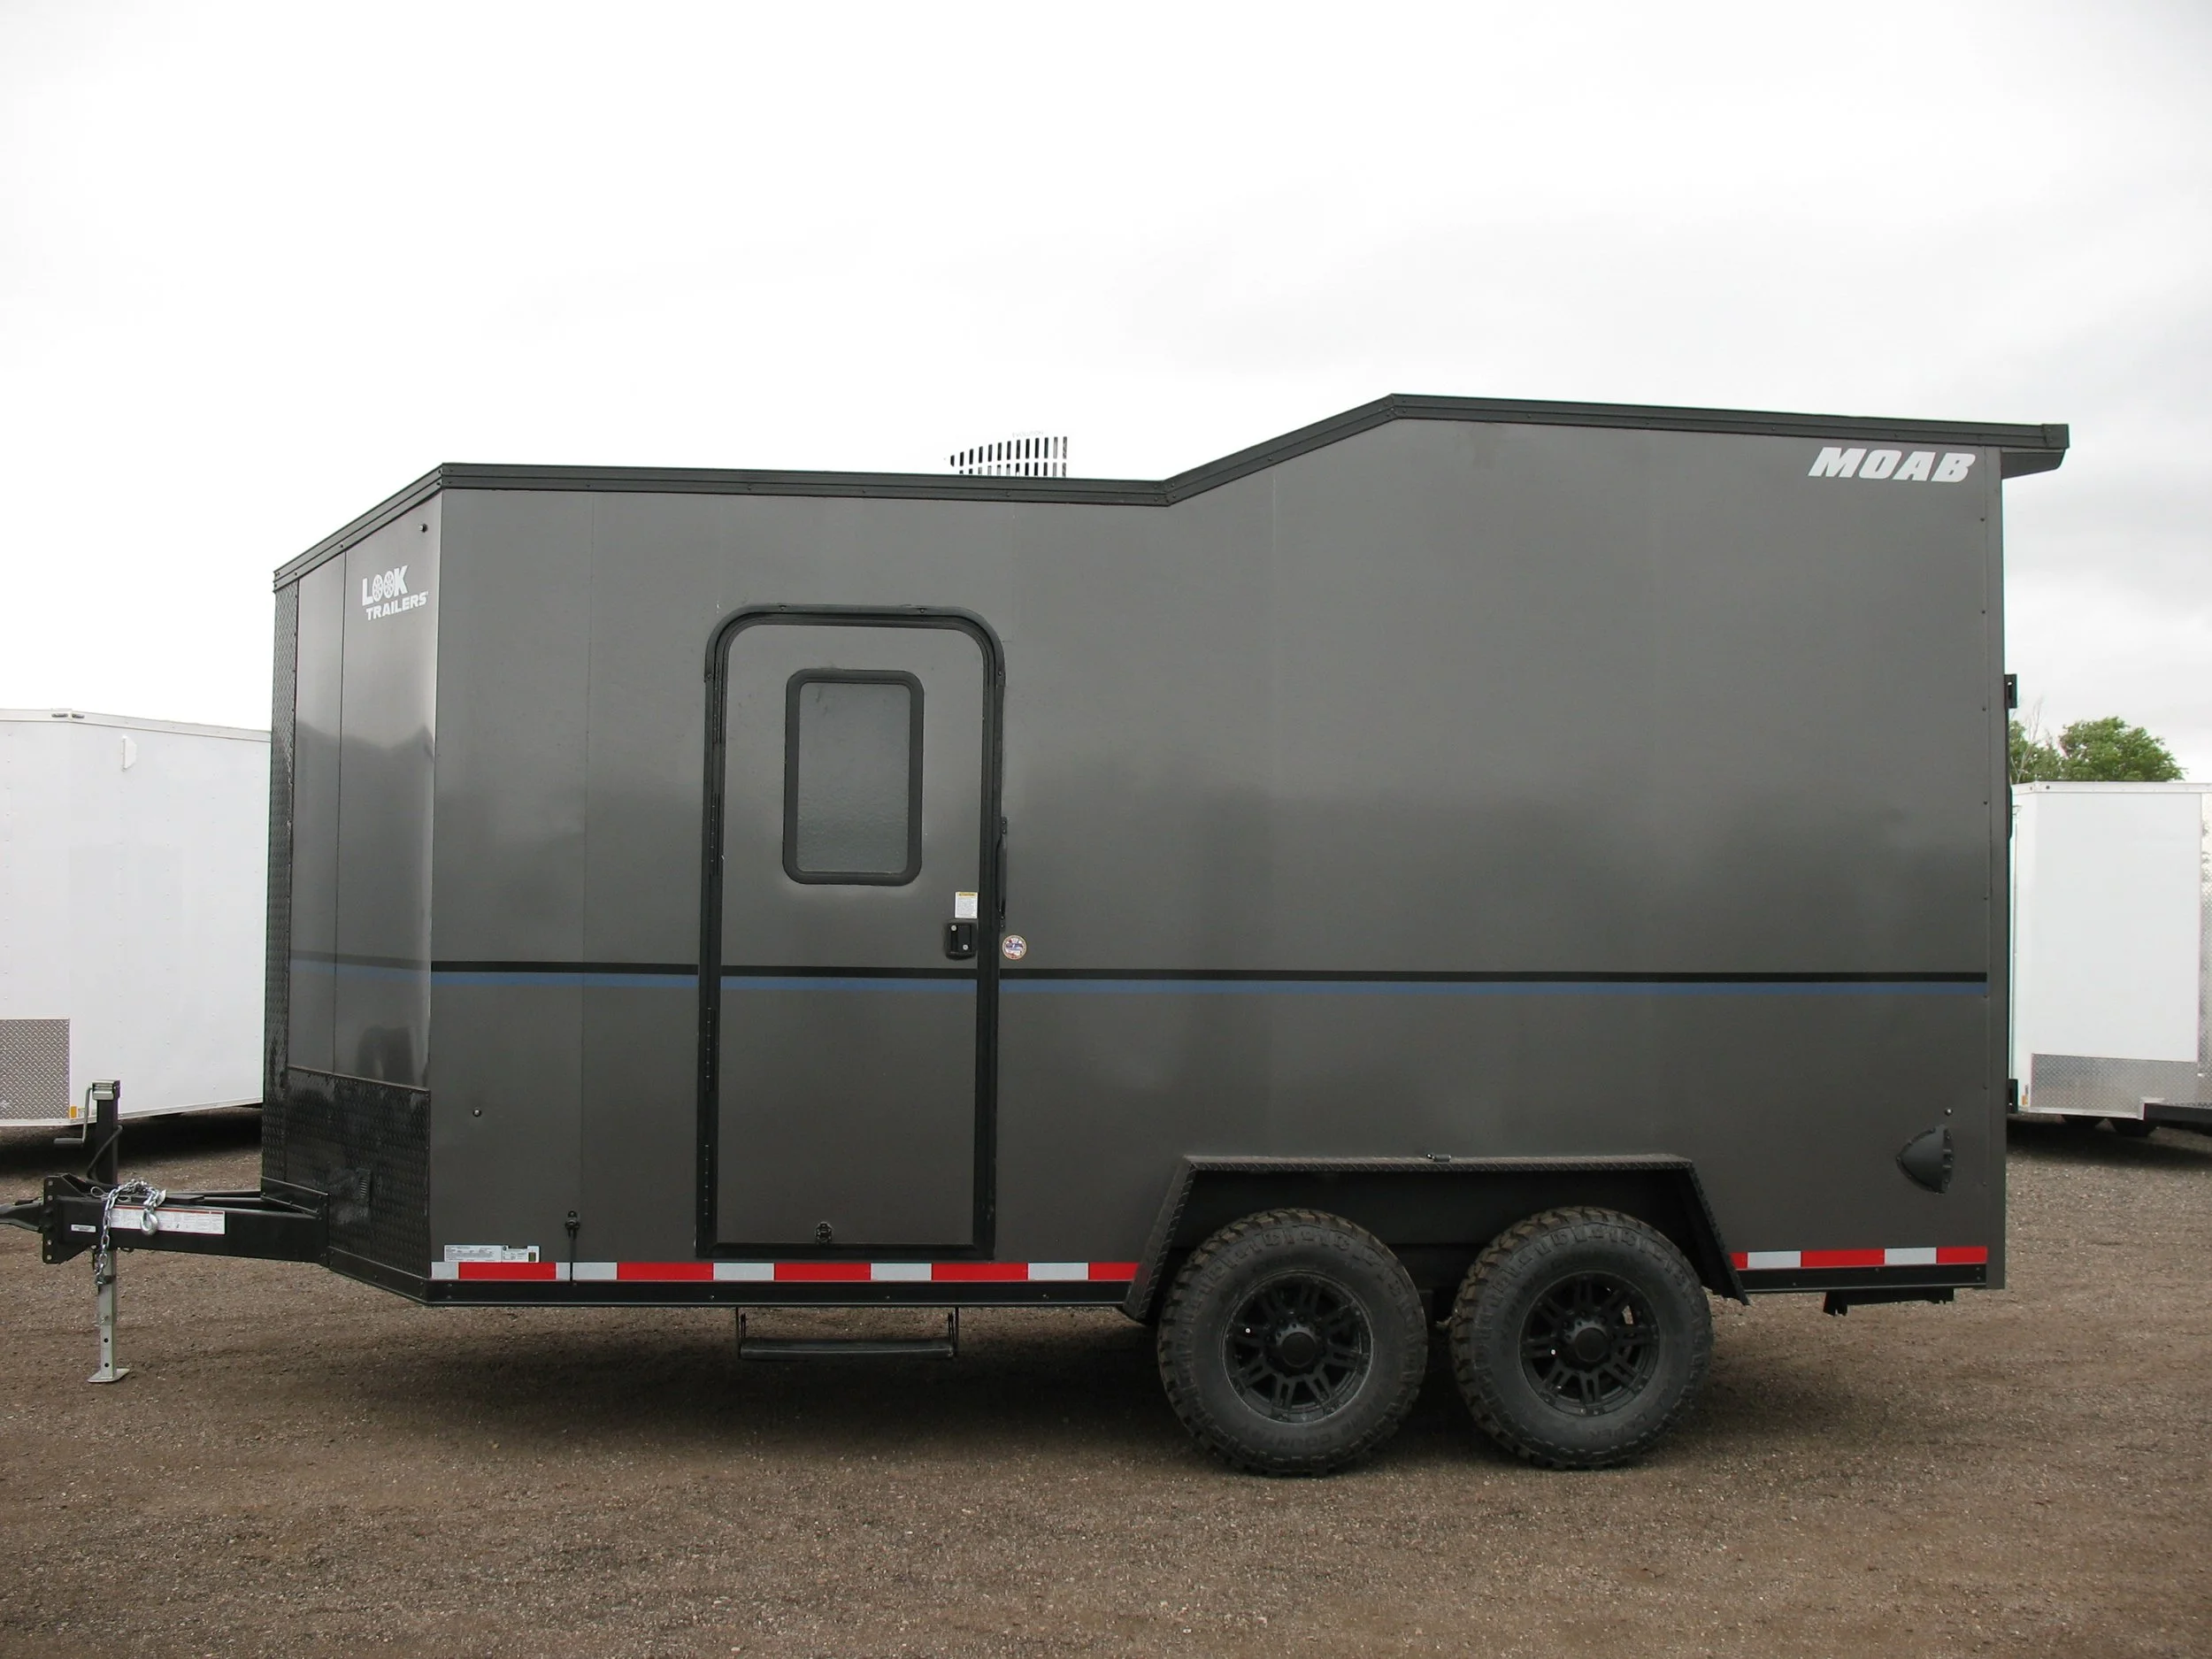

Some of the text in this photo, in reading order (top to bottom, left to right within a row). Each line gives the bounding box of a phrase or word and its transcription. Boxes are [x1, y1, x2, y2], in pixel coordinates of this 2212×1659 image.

[1808, 447, 1976, 483] MOAB
[362, 565, 408, 606] LOOK
[365, 591, 427, 621] TRAILERS
